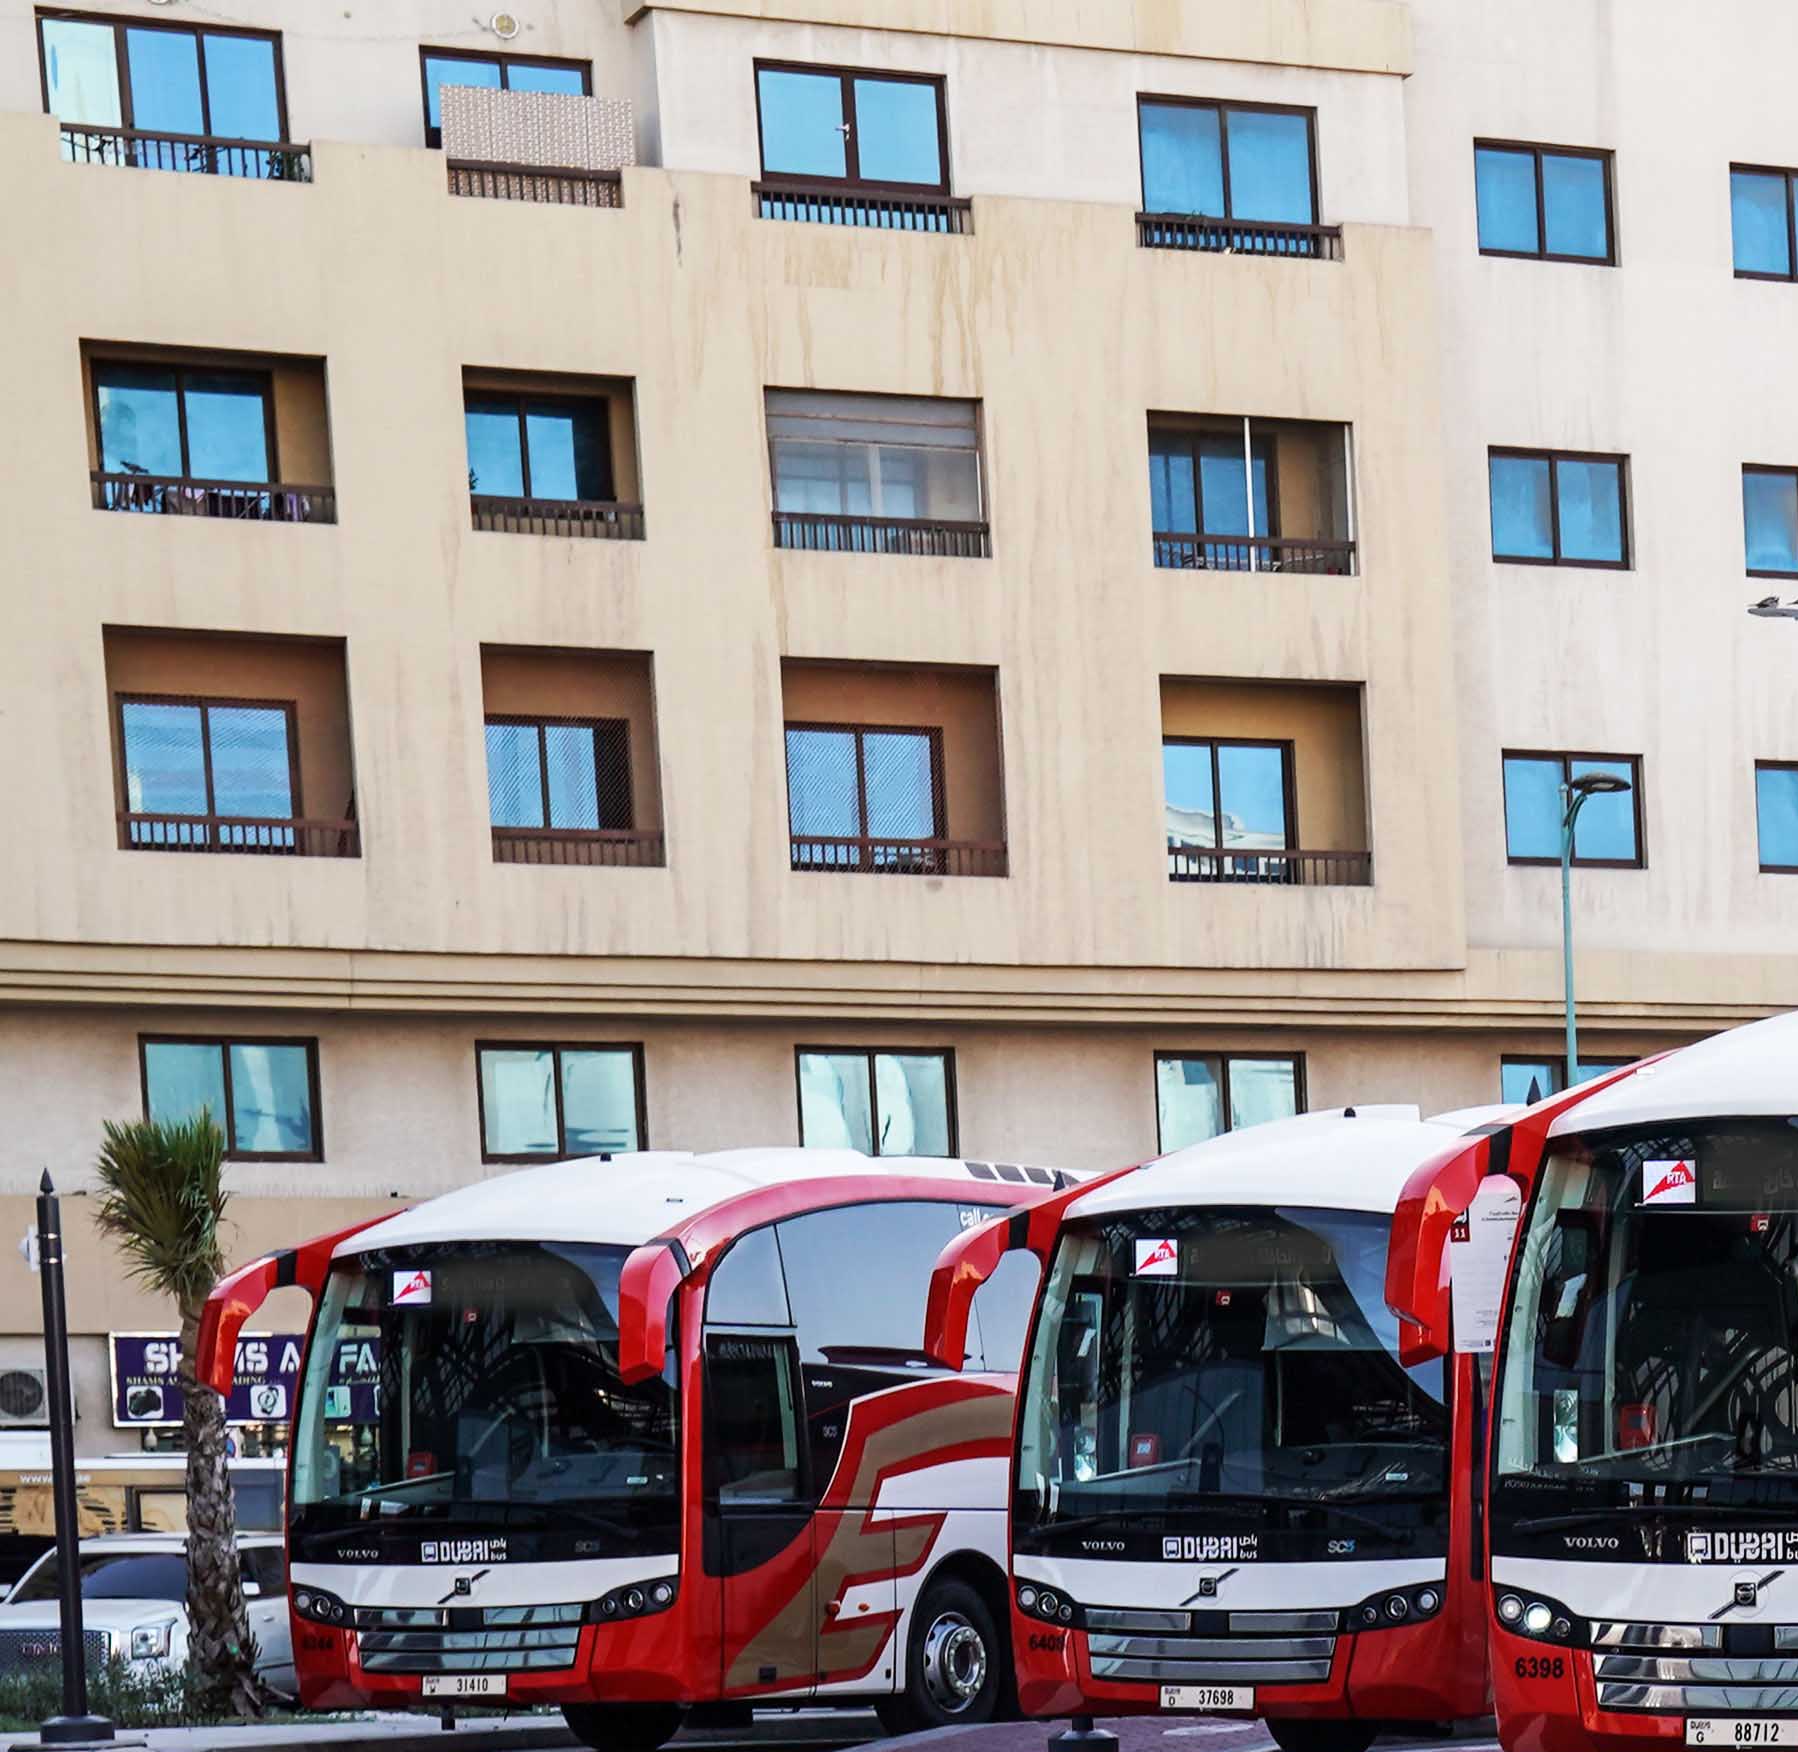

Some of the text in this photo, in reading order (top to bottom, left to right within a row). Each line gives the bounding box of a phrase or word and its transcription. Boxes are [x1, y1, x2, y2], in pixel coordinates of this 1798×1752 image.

[1666, 1171, 1687, 1185] RTA
[1454, 1228, 1466, 1239] 11
[1082, 1540, 1126, 1551] VOLVO
[1184, 1536, 1238, 1560] DUBAI
[1563, 1537, 1619, 1550] VOLVO
[1714, 1532, 1783, 1562] DUBAI
[338, 1549, 379, 1559] VOLVO
[440, 1540, 489, 1563] DUBAI
[490, 1551, 507, 1561] bus
[1240, 1549, 1258, 1560] bus
[1514, 1657, 1564, 1679] 6398
[457, 1678, 489, 1693] 31410
[1198, 1689, 1234, 1705] 37698
[1734, 1722, 1780, 1742] 88712
